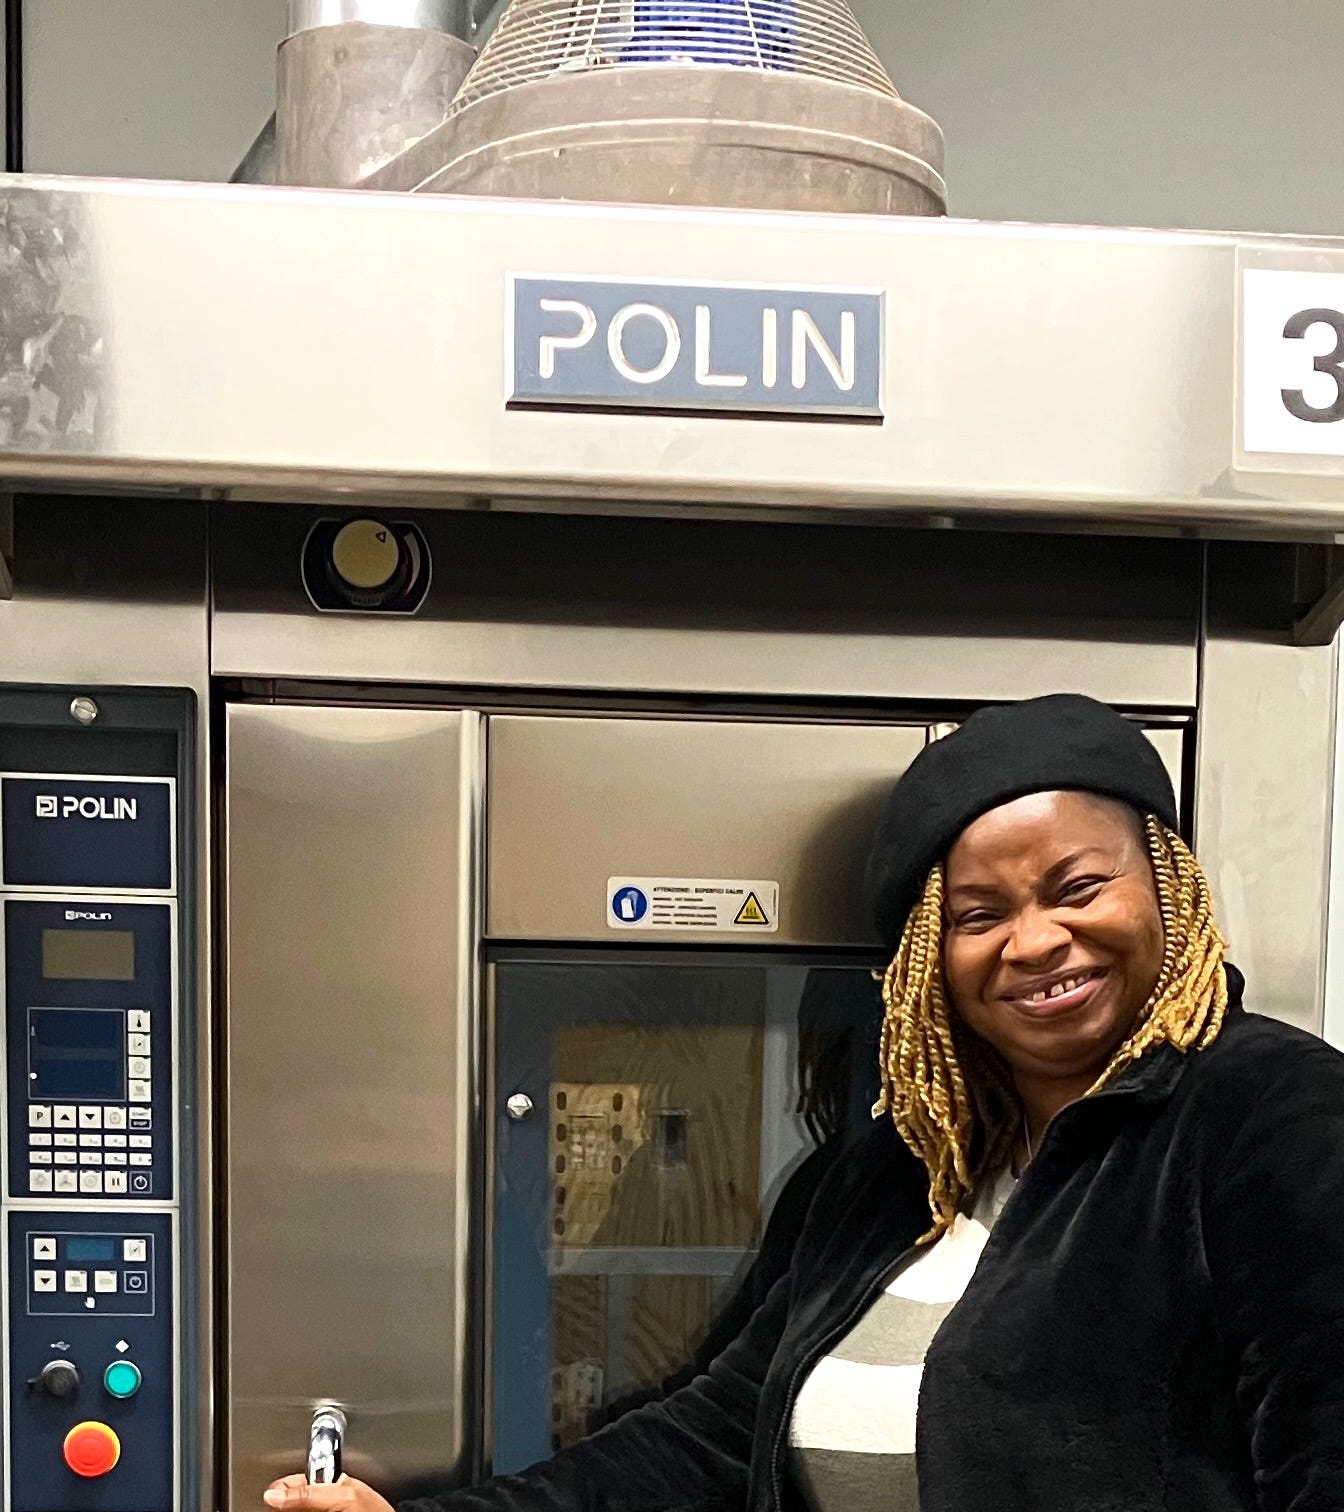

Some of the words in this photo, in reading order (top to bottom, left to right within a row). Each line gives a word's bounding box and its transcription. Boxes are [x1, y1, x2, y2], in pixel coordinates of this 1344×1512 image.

[539, 297, 856, 391] POLIN
[63, 795, 137, 820] POLIN
[75, 911, 112, 920] POLIN
